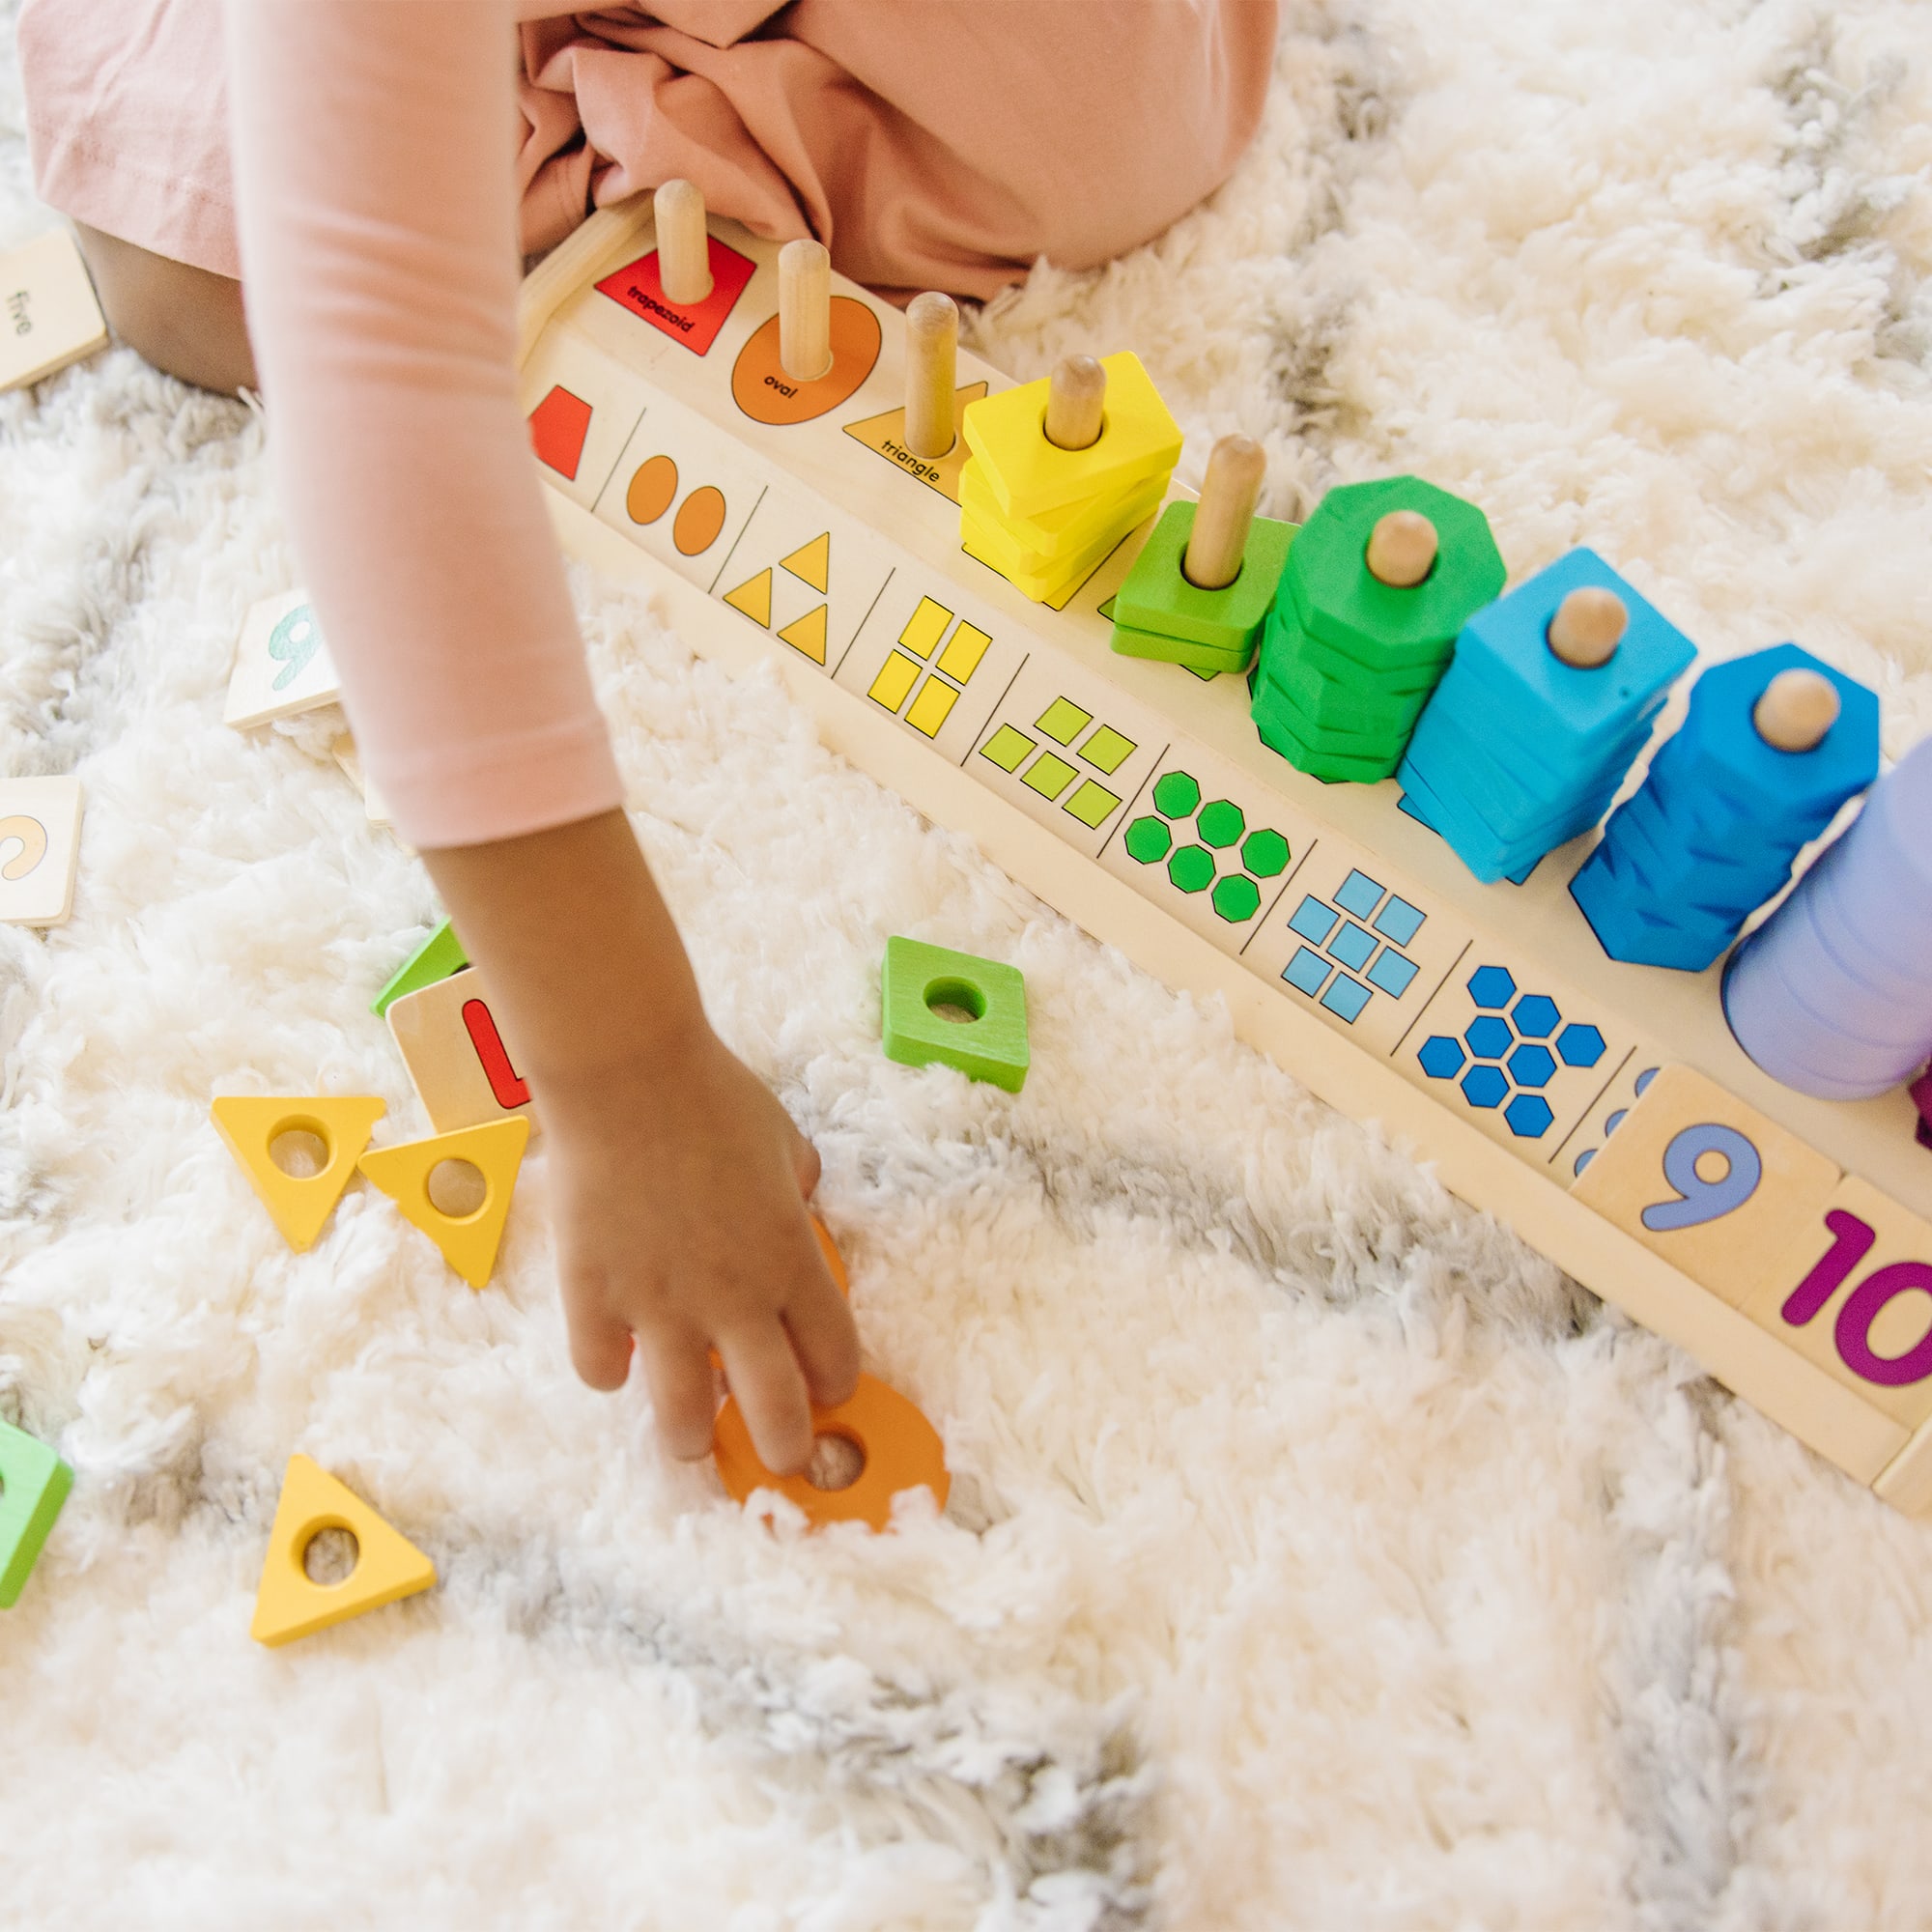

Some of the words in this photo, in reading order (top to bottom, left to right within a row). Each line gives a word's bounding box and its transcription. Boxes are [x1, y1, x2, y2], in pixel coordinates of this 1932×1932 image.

[6, 291, 33, 336] five
[627, 285, 696, 333] trapezoid
[763, 374, 799, 400] oval
[881, 440, 941, 484] triangle
[1640, 1122, 1763, 1232] 9
[1780, 1208, 1932, 1388] 10
